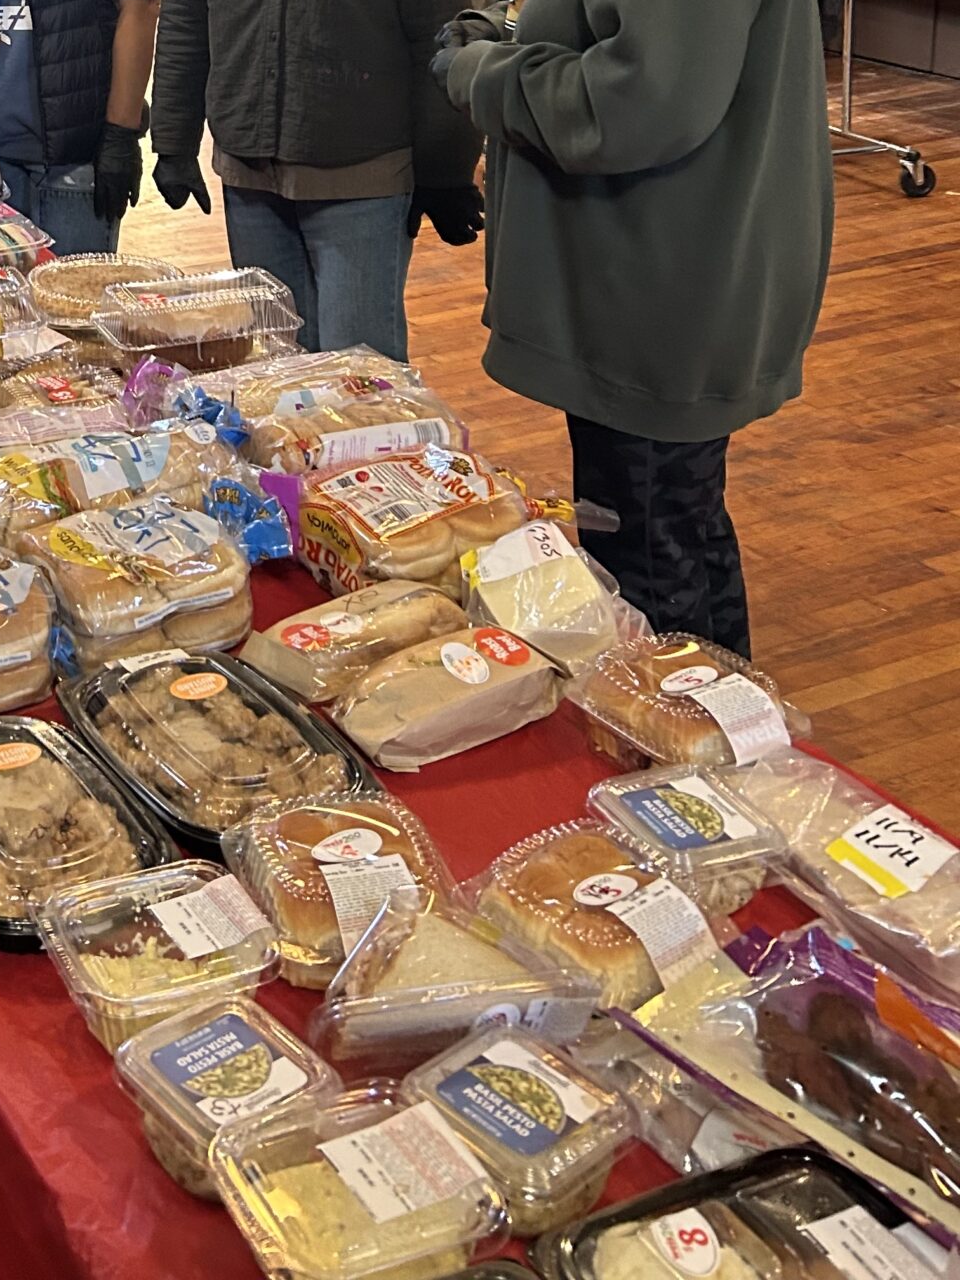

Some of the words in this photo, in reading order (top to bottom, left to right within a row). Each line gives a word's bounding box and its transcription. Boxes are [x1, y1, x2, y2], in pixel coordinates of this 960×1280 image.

[480, 636, 511, 663] Roast
[495, 634, 523, 653] Beef
[641, 800, 665, 819] PASTA
[662, 818, 688, 839] SALAD
[652, 799, 675, 817] BASIL
[670, 815, 695, 835] PESTO
[854, 829, 920, 868] 11/14
[206, 1031, 238, 1049] PASTA
[219, 1040, 244, 1058] BASIL
[176, 1047, 208, 1067] SALAD
[187, 1054, 220, 1074] PESTO
[461, 1087, 496, 1112] PASTA
[492, 1109, 531, 1138] SALAD
[473, 1083, 505, 1109] BASIL
[501, 1105, 537, 1129] PESTO
